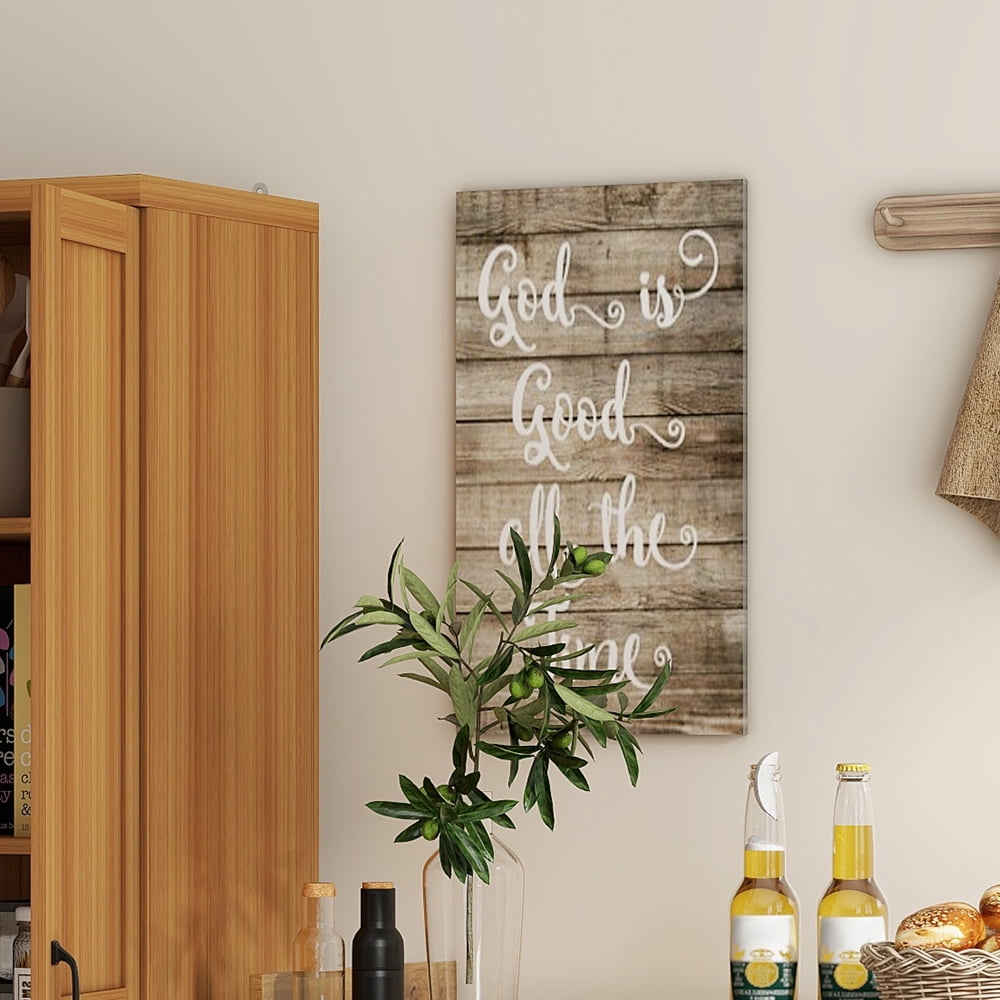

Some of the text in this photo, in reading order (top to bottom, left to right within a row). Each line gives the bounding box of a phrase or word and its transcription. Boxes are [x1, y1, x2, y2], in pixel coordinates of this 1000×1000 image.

[477, 229, 720, 352] God is
[511, 358, 687, 472] Good
[588, 473, 698, 571] the
